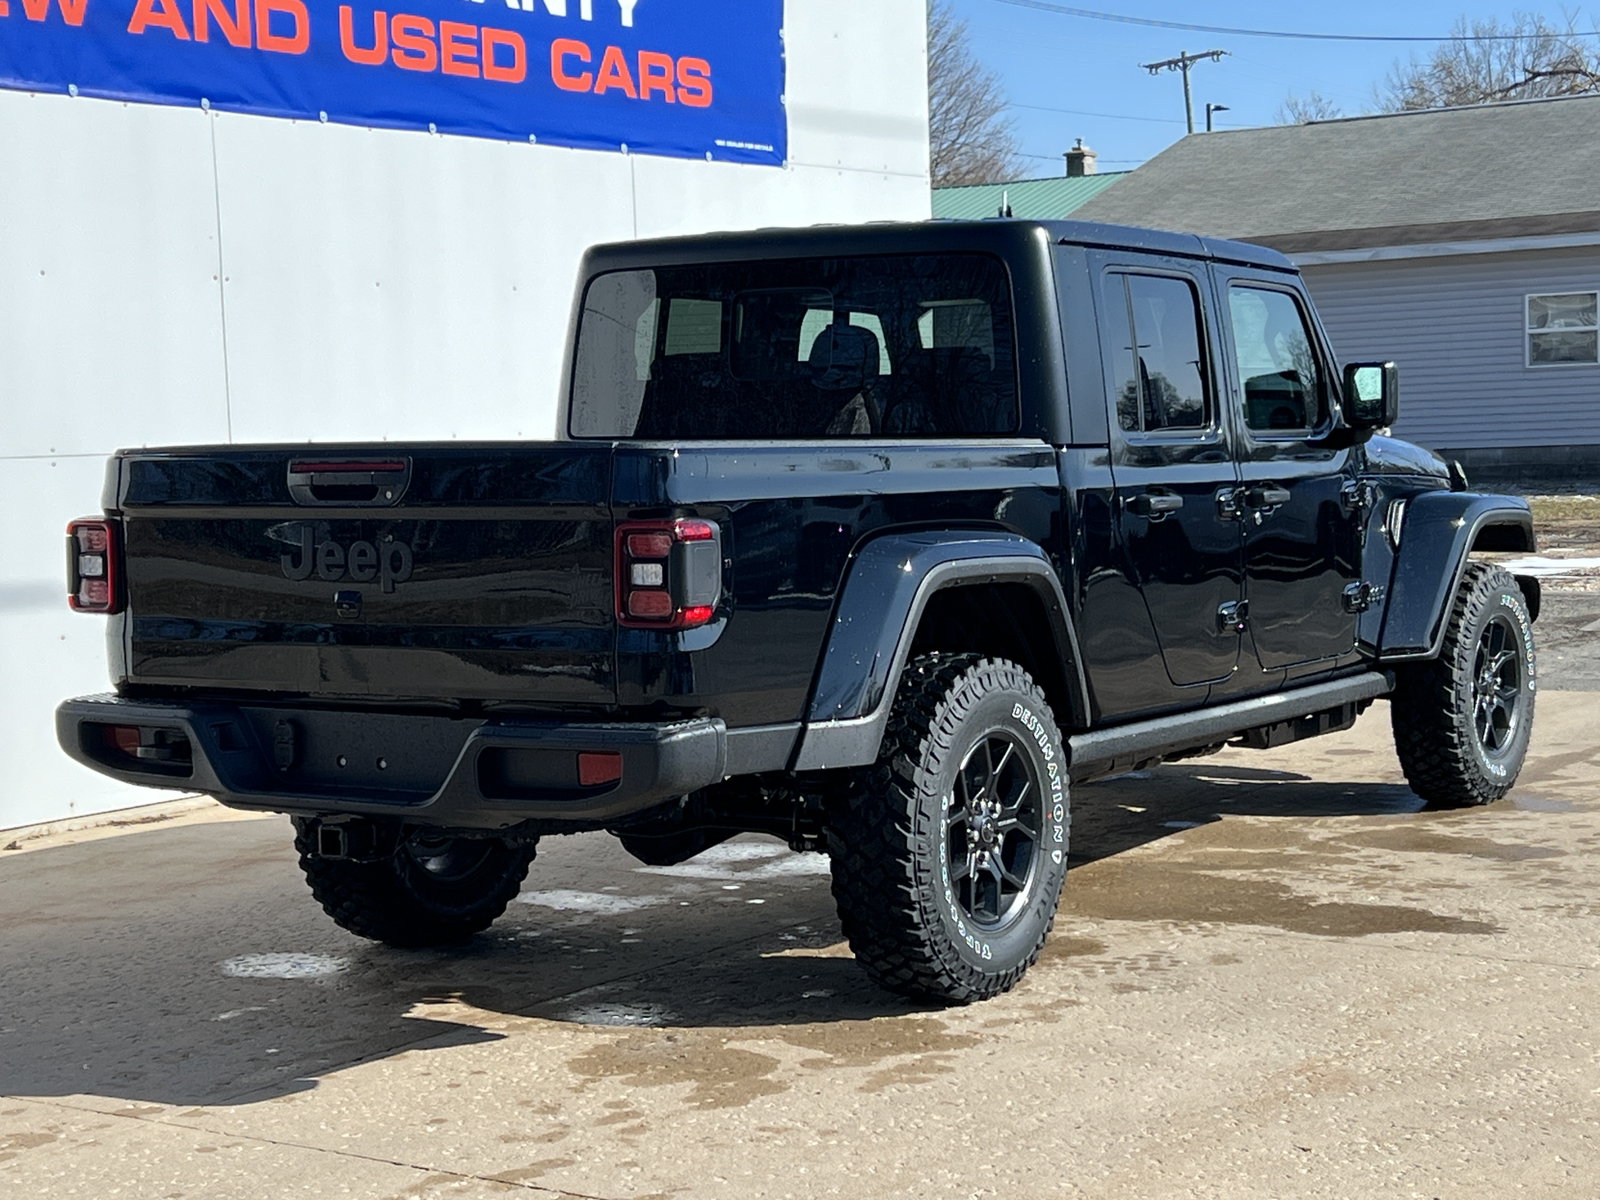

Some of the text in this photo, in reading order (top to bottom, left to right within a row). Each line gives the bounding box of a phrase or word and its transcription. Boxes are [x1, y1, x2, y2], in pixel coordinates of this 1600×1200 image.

[127, 0, 713, 108] AND USED CARS
[281, 526, 413, 593] Jeep
[1011, 703, 1064, 843] DESTINATION
